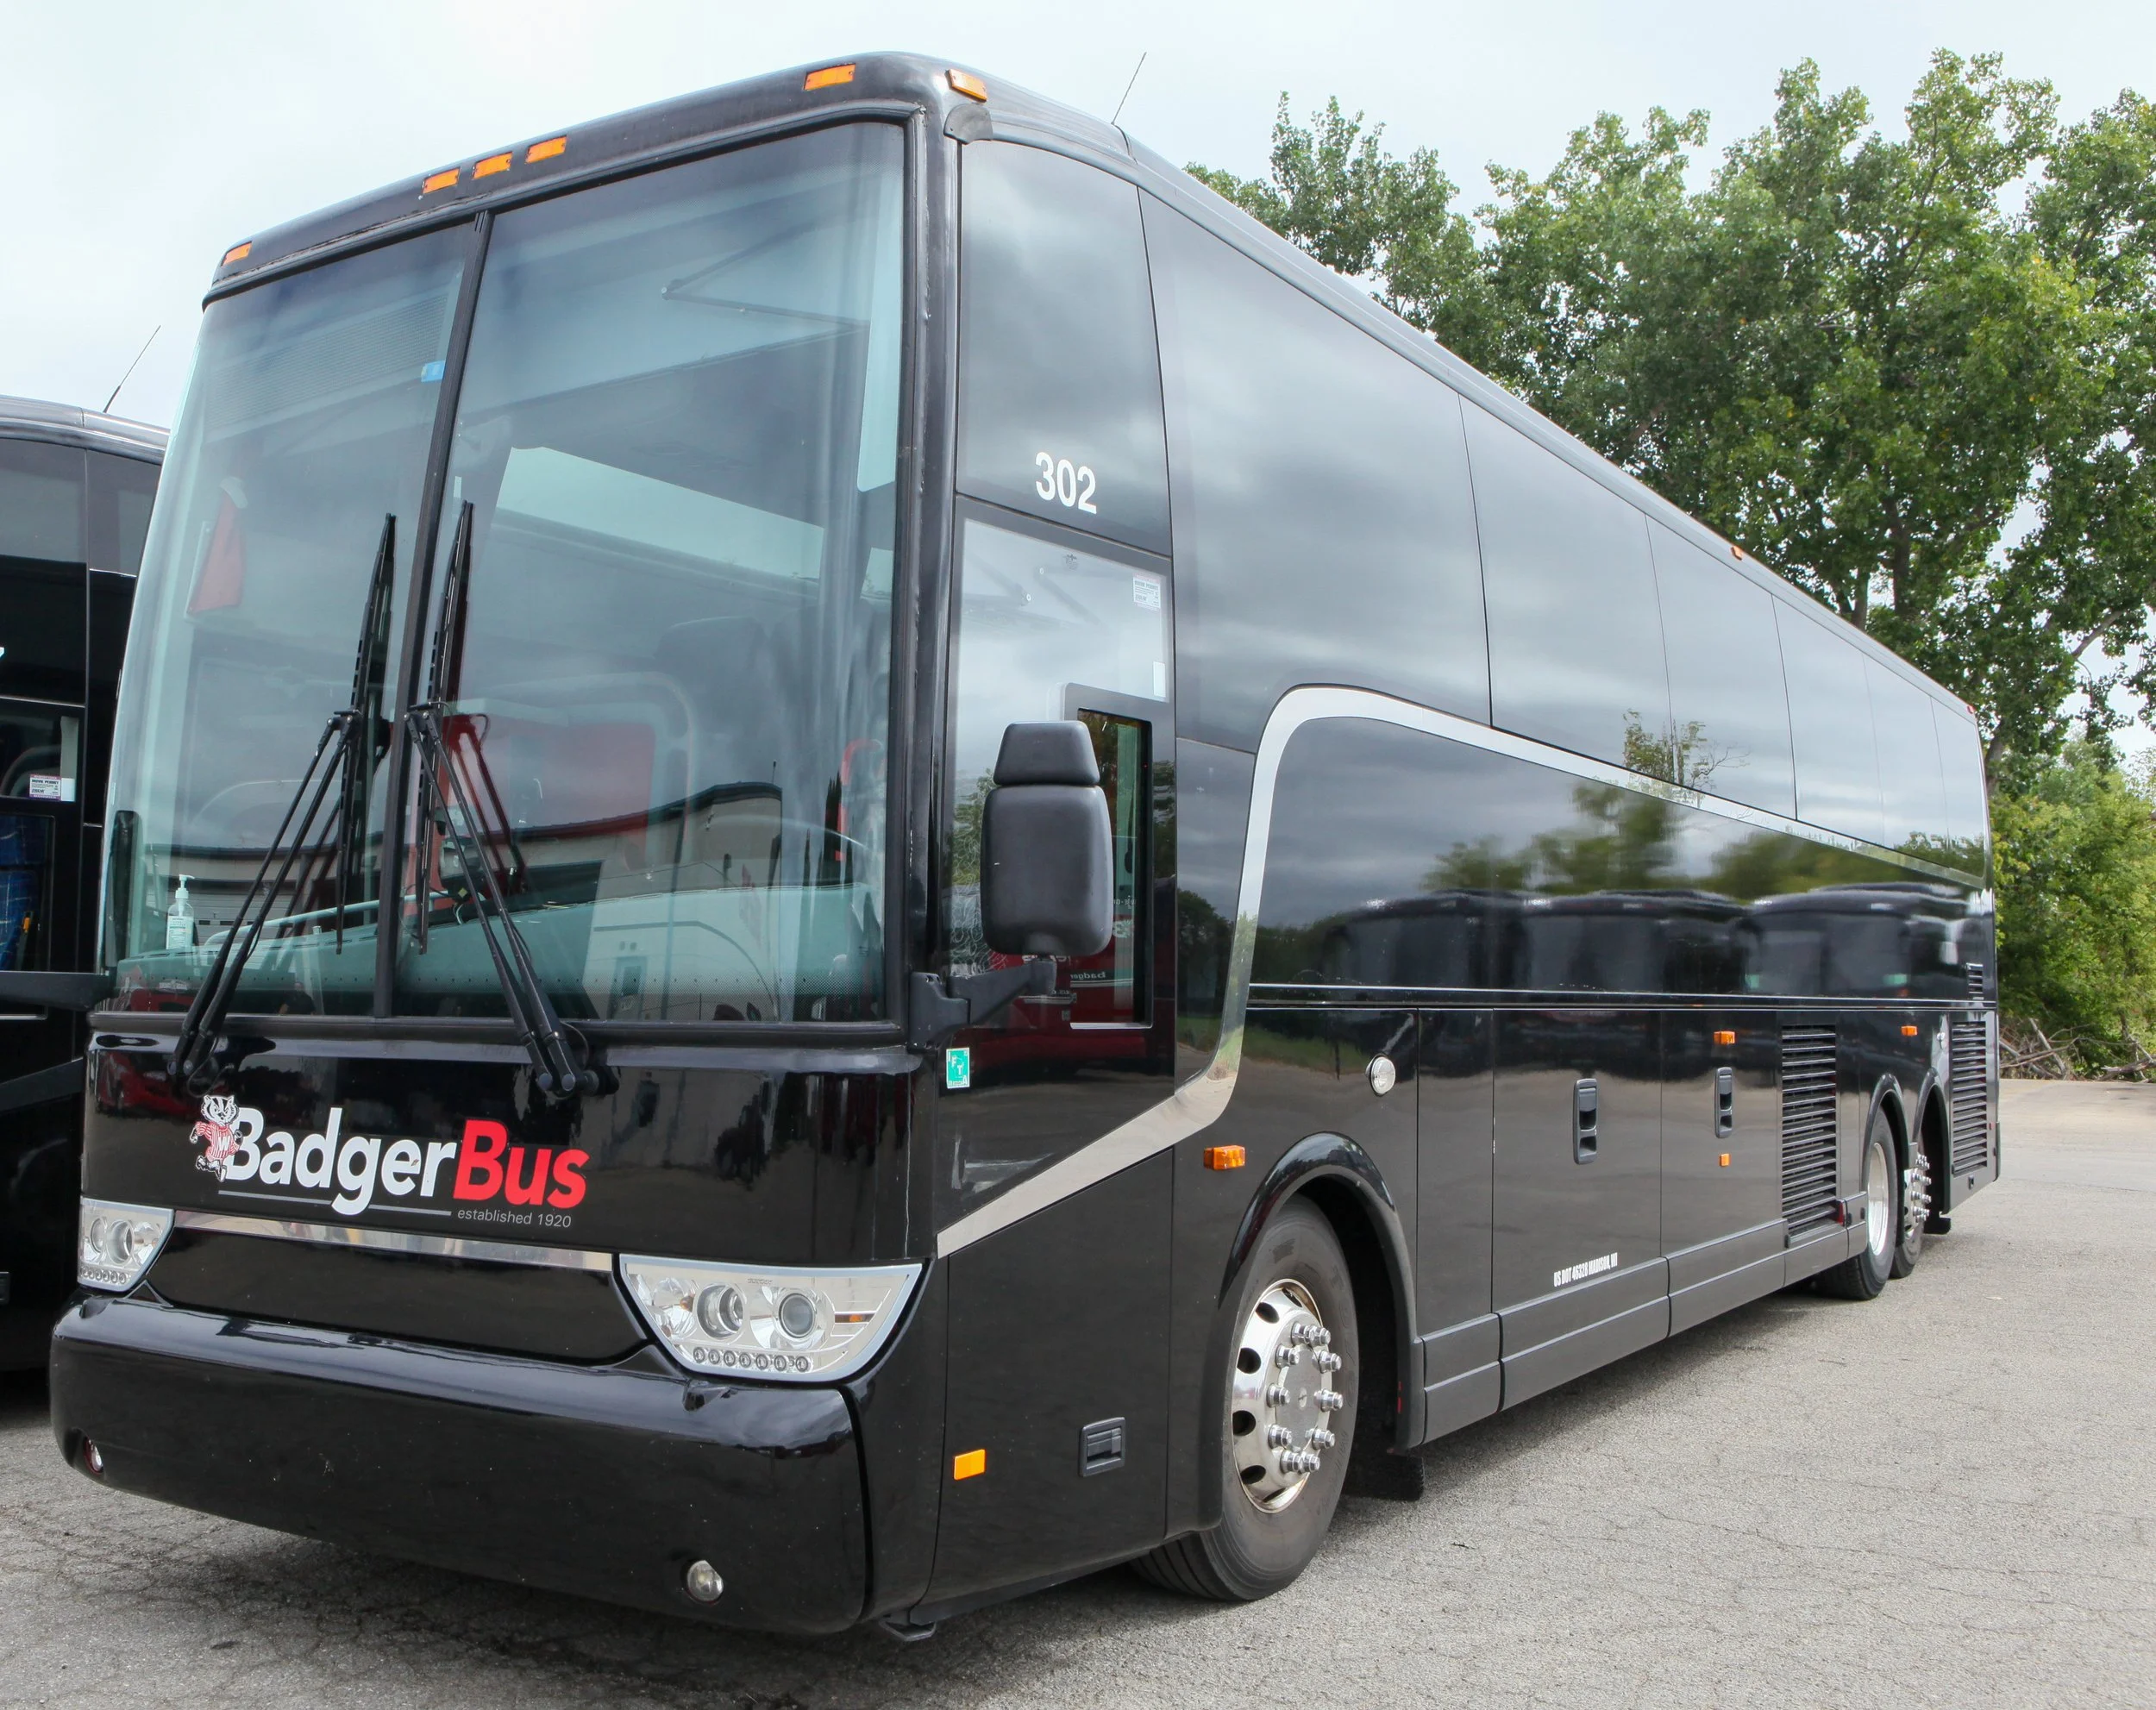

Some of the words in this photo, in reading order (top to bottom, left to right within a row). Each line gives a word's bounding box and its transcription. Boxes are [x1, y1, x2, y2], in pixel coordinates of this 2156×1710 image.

[1036, 452, 1097, 514] 302
[457, 1208, 532, 1225] established
[537, 1213, 572, 1228] 1920
[1553, 1270, 1562, 1287] US
[1562, 1267, 1572, 1285] DOT
[1610, 1252, 1618, 1268] WI
